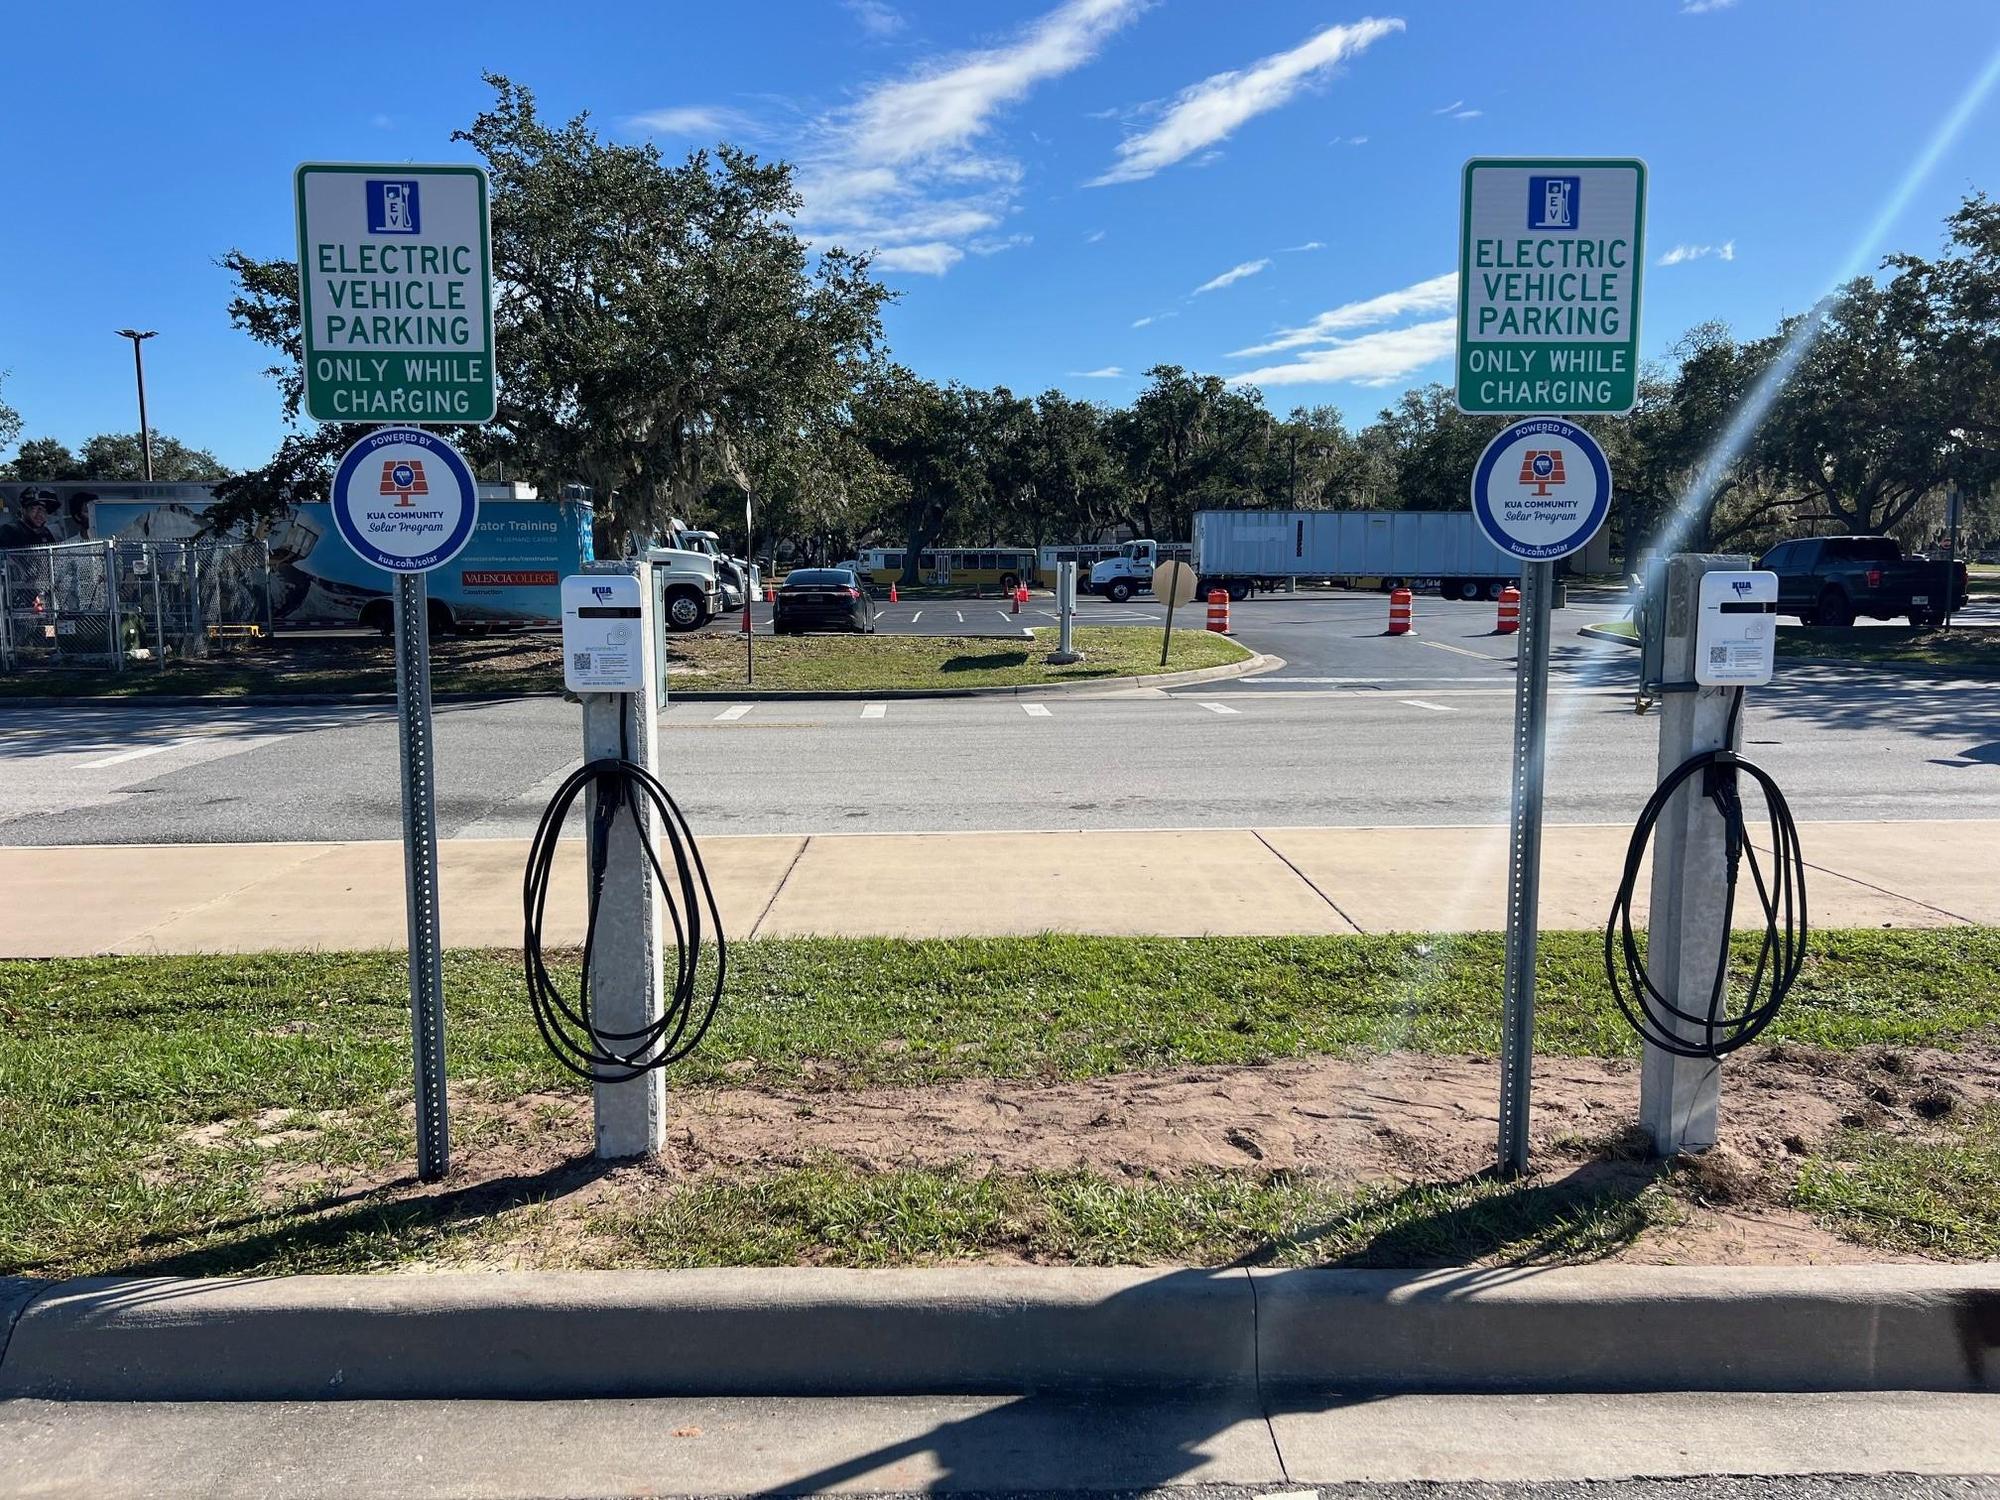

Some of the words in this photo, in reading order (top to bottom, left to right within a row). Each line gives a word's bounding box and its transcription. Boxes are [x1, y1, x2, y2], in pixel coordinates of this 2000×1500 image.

[318, 244, 472, 275] ELECTRIC
[1476, 239, 1627, 268] ELECTRIC
[327, 280, 466, 310] VEHICLE
[1483, 273, 1618, 302] VEHICLE
[327, 315, 469, 345] PARKING
[1478, 306, 1620, 336] PARKING
[316, 358, 389, 382] ONLY
[404, 359, 483, 383] WHILE
[1468, 350, 1537, 373] ONLY
[1549, 350, 1627, 373] WHILE
[333, 389, 469, 413] CHARGING
[1480, 380, 1612, 404] CHARGING
[371, 433, 417, 447] POWERED
[419, 436, 433, 447] BY
[1515, 423, 1560, 437] POWERED
[1561, 426, 1574, 437] BY
[367, 512, 386, 520] KUA
[388, 511, 444, 520] COMMUNITY
[1504, 500, 1522, 509] KUA
[1524, 500, 1579, 509] COMMUNITY
[368, 522, 397, 533] Solar
[399, 522, 444, 536] Program
[475, 521, 506, 531] rator
[508, 520, 558, 533] Training
[1504, 511, 1532, 521] Solar
[1534, 511, 1577, 524] Program
[378, 554, 438, 568] kua.com/solar
[1510, 542, 1569, 557] kua.com/solar
